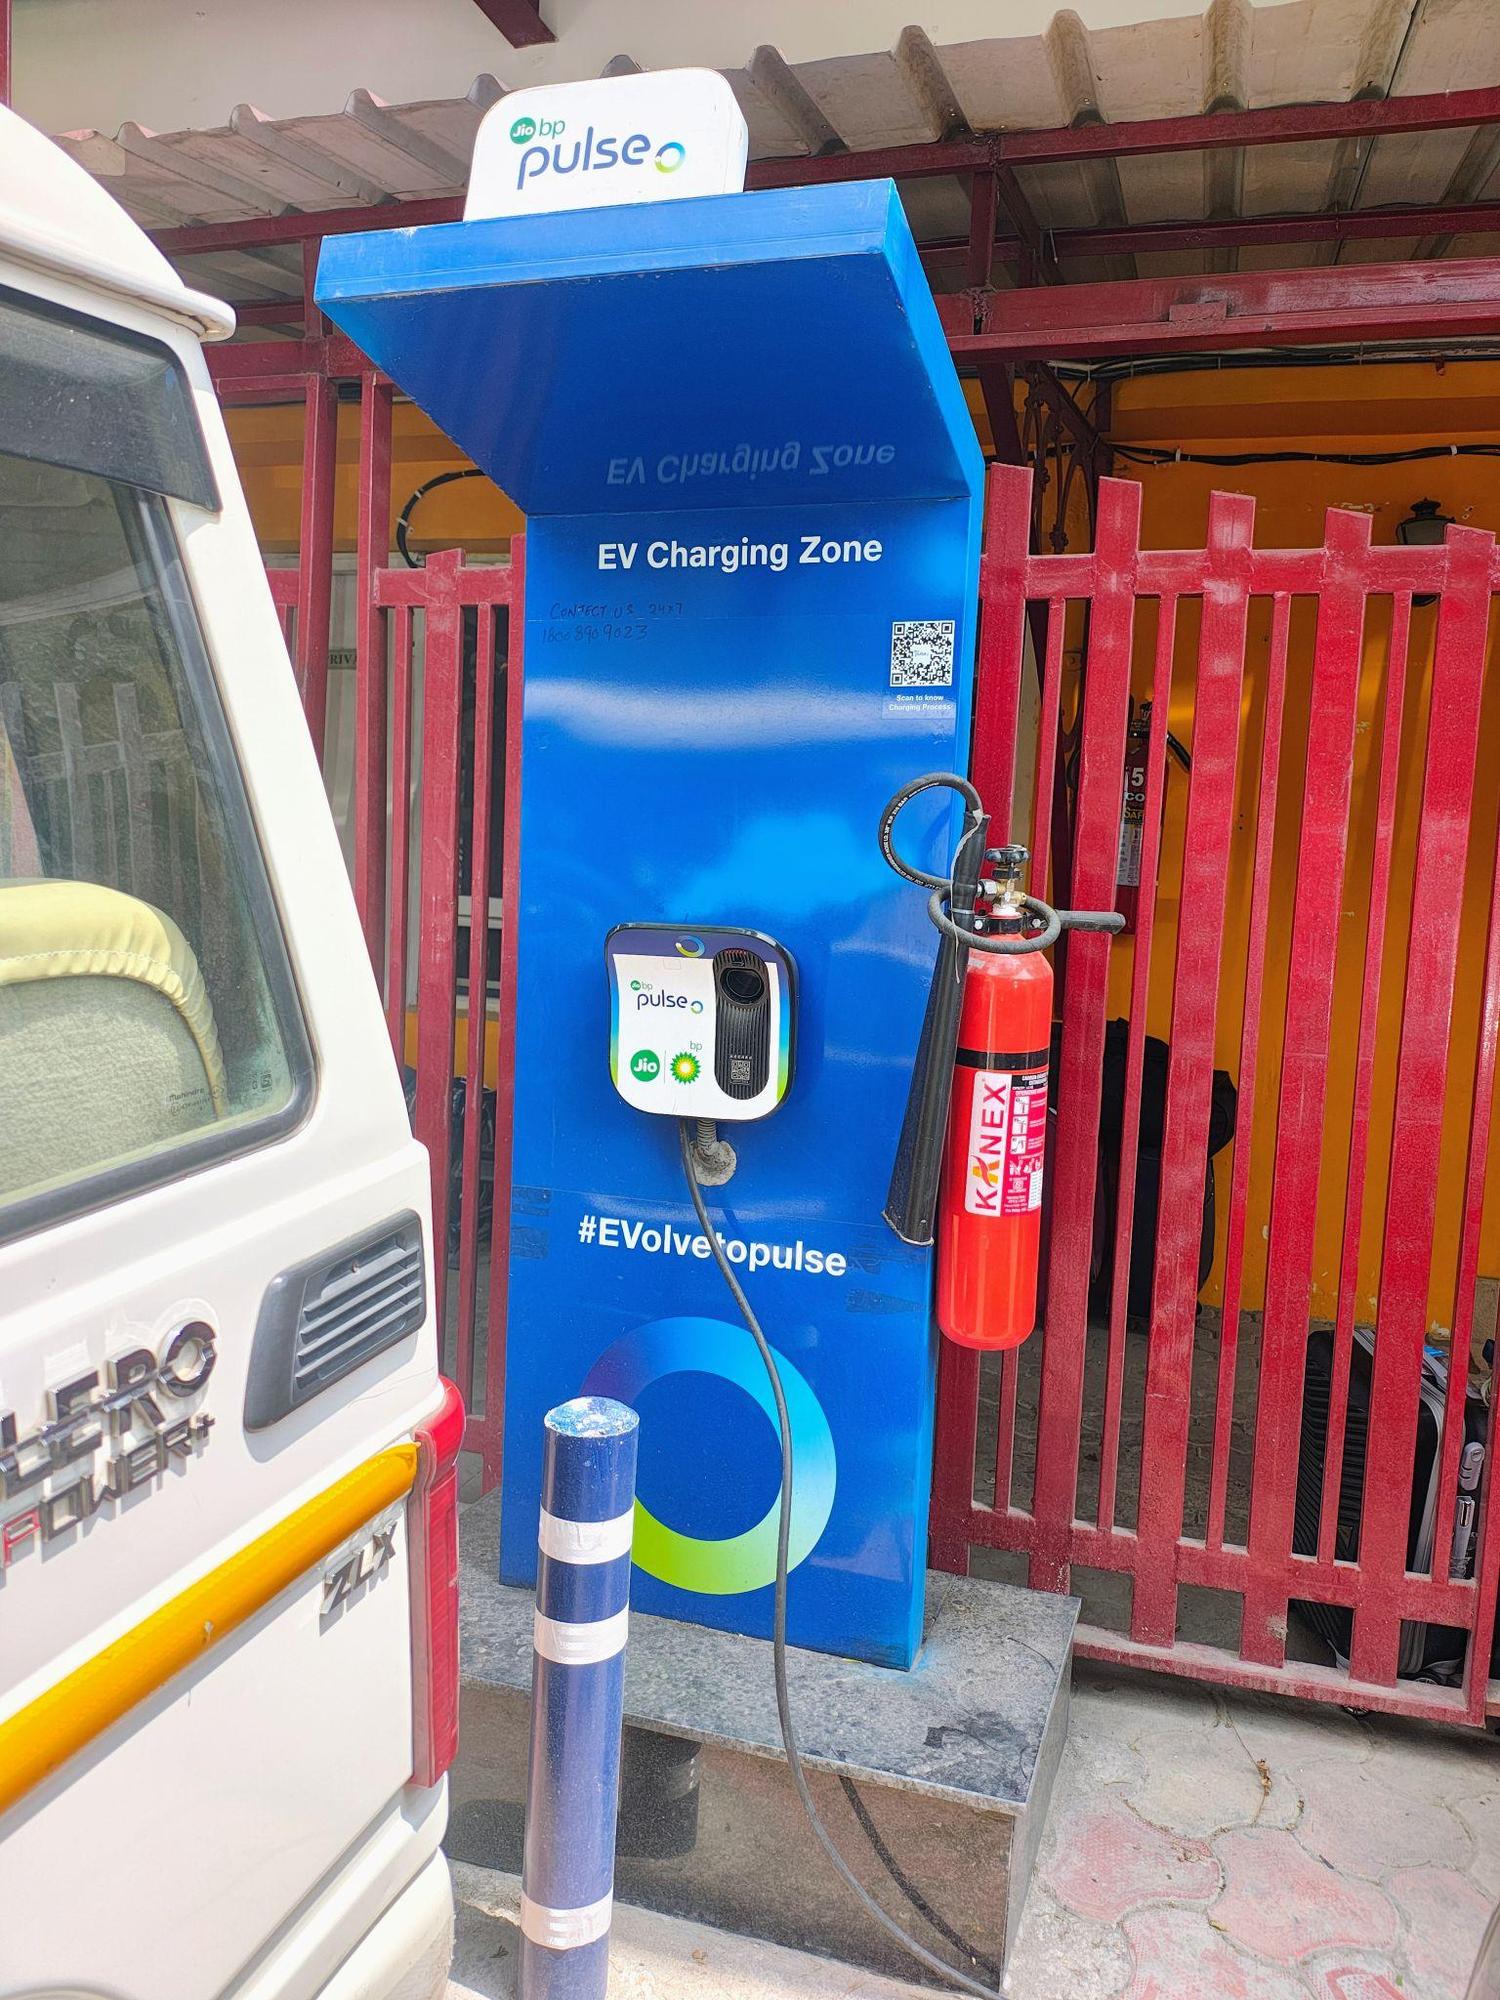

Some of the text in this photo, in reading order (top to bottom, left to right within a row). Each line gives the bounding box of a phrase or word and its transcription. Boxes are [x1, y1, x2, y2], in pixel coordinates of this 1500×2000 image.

[511, 117, 566, 140] Jio bp
[516, 126, 651, 190] pulse
[598, 536, 883, 573] EV Charging Zone
[328, 653, 357, 665] RIV
[889, 703, 953, 712] Charging Process
[641, 981, 653, 991] bp
[637, 989, 688, 1010] pulse
[689, 1040, 703, 1052] bp
[632, 1055, 658, 1076] Jio
[320, 1520, 398, 1615] ZLX
